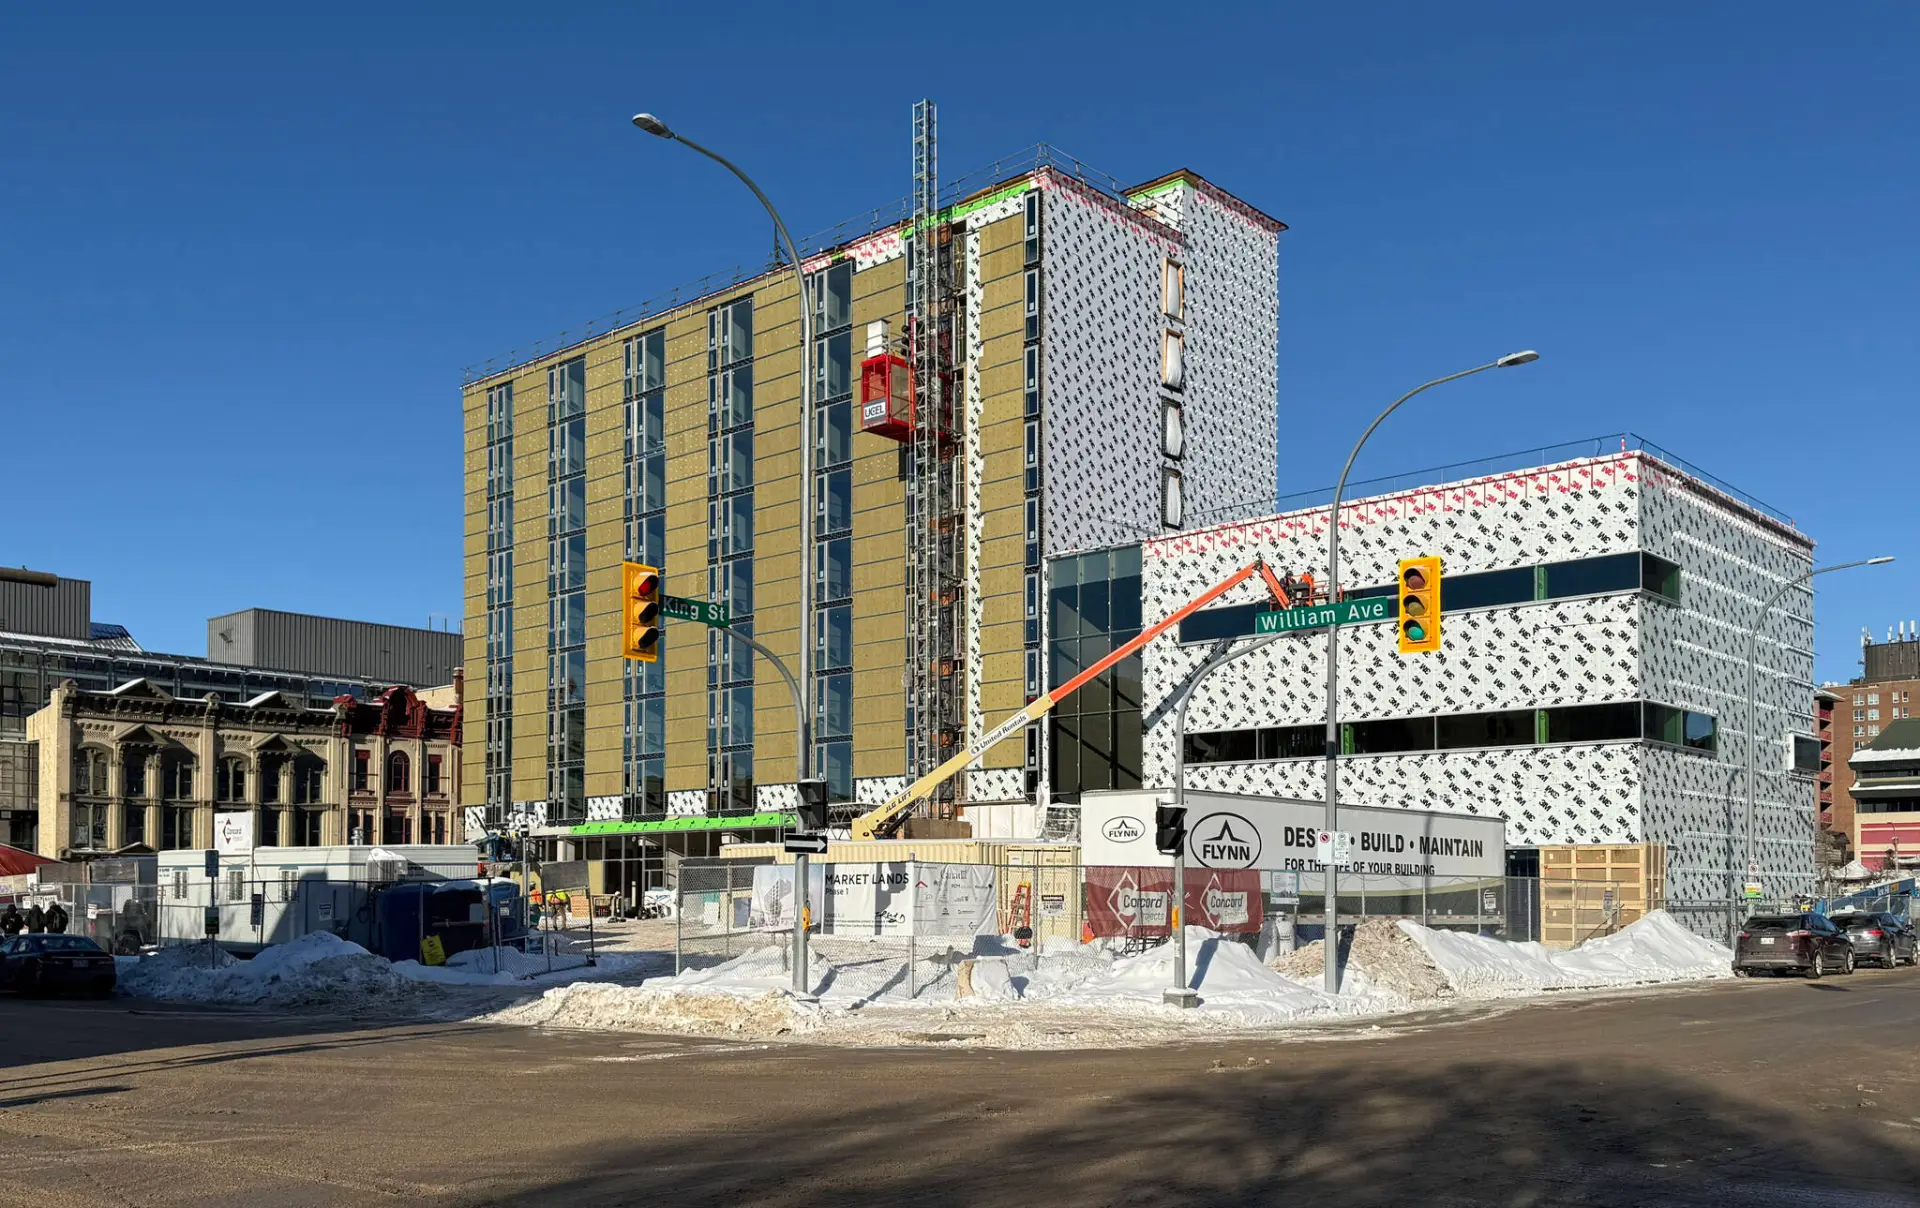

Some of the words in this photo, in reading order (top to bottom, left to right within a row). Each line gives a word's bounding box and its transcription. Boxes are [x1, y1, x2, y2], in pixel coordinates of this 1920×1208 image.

[663, 596, 699, 620] King
[708, 604, 724, 622] St
[1262, 610, 1336, 631] William
[1348, 604, 1383, 620] Ave
[980, 731, 1002, 748] United
[1002, 716, 1027, 734] Rentals
[885, 802, 896, 814] JLG
[898, 791, 912, 804] LIFT
[1108, 830, 1138, 838] FLYNN
[1203, 844, 1250, 861] FLYNN
[1361, 832, 1404, 852] BUILD
[1420, 836, 1483, 858] MAINTAIN
[1285, 858, 1304, 871] FOR
[1353, 861, 1364, 872] OF
[1368, 862, 1392, 874] YOUR
[1395, 863, 1435, 875] BUILDING
[825, 874, 869, 885] MARKET
[872, 873, 909, 884] LANDS
[1211, 895, 1243, 908] Concord
[1142, 912, 1164, 922] rojects
